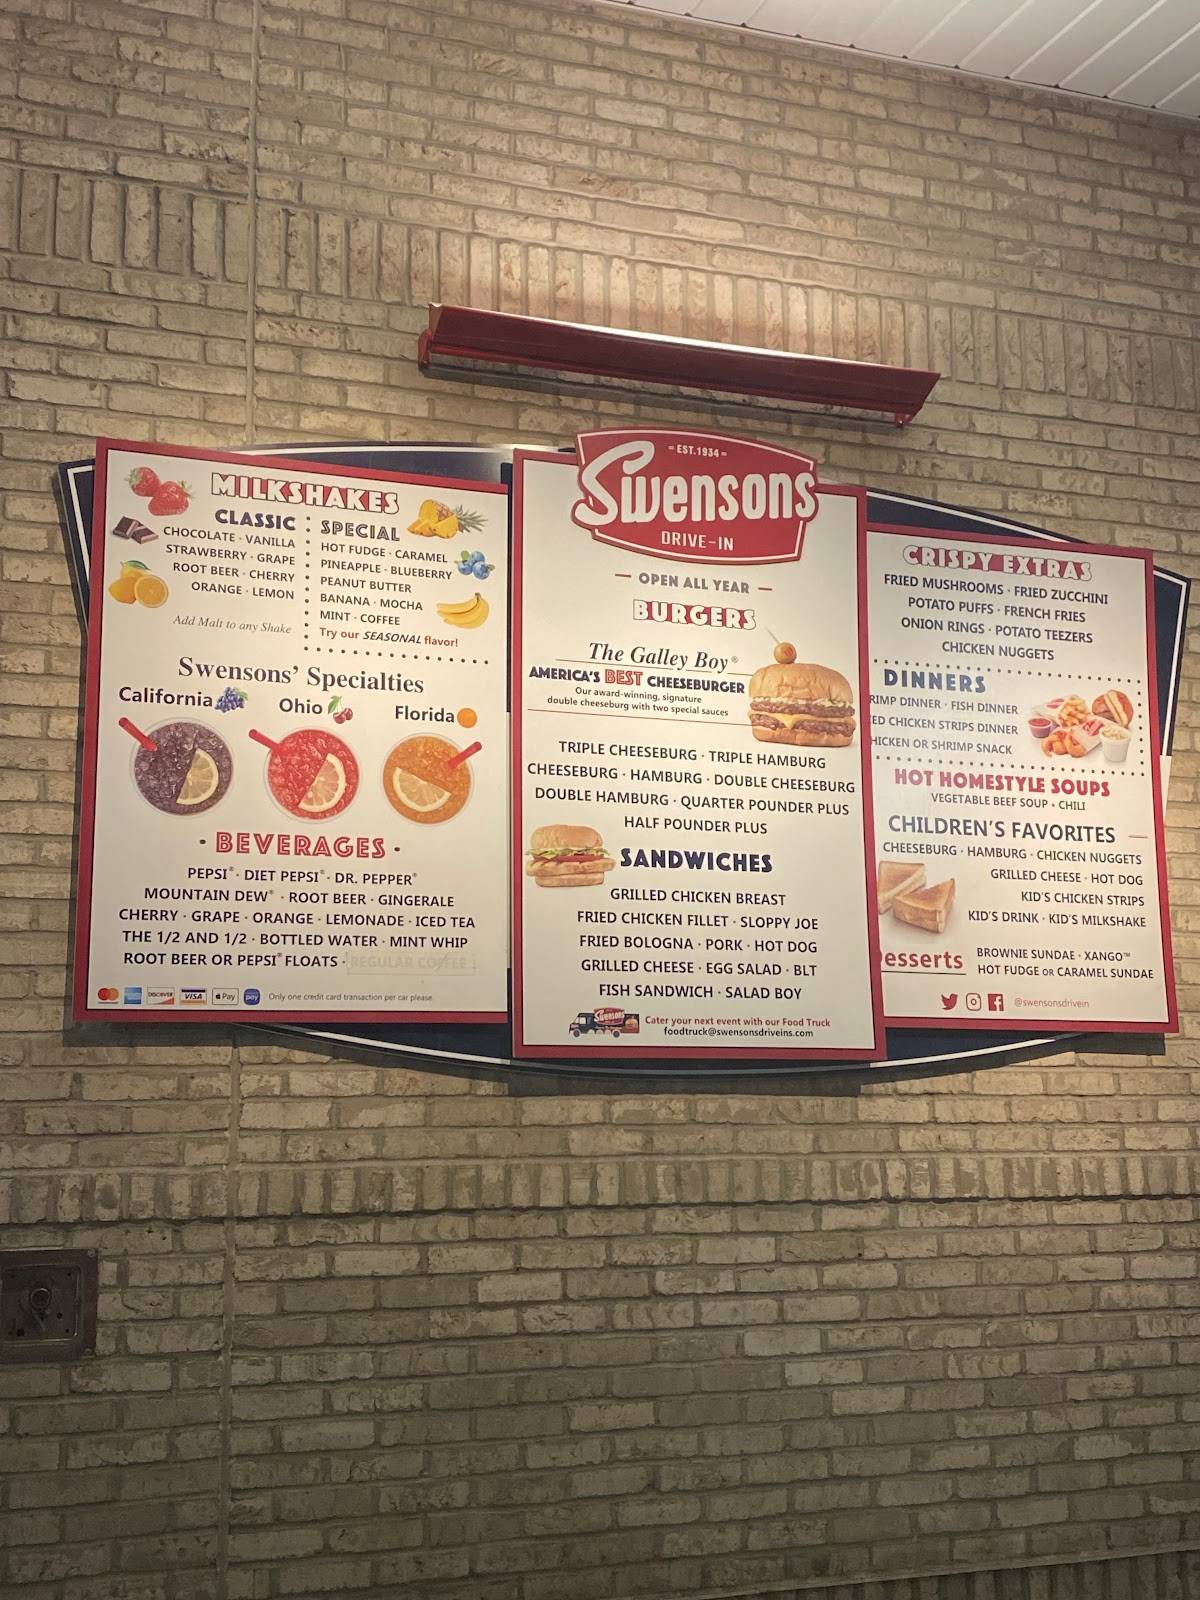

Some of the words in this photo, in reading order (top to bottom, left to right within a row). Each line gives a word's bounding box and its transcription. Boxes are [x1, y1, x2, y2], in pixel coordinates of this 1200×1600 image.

[575, 441, 816, 525] Swensons
[210, 472, 400, 515] MILKSHAKES
[215, 509, 296, 531] CLASSIC
[163, 526, 235, 542] CHOCOLATE
[246, 535, 295, 548] VANILLA
[321, 520, 400, 541] SPECIAL
[661, 530, 734, 551] DRIVE-IN
[166, 544, 247, 560] STRAWBERRY
[257, 553, 295, 565] GRAPE
[321, 542, 345, 553] HOT
[349, 545, 385, 557] FUDGE
[395, 550, 448, 563] CARAMEL
[321, 559, 381, 573] PINEAPPLE
[391, 566, 452, 580] BLUEBERRY
[902, 544, 993, 572] CRISPY
[1003, 549, 1093, 582] EXTRAS
[192, 582, 242, 595] ORANGE
[252, 587, 294, 600] LEMON
[321, 576, 366, 588] PEANUT
[370, 580, 412, 593] BUTTER
[638, 572, 679, 587] OPEN
[683, 576, 708, 590] ALL
[713, 579, 750, 594] YEAR
[884, 573, 919, 587] FRIED
[922, 577, 1004, 595] MUSHROOMS
[1014, 585, 1048, 599] FRIED
[1051, 588, 1108, 605] ZUCCHINI
[320, 611, 350, 621] MINT
[360, 614, 400, 625] COFFEE
[633, 599, 757, 630] BURGERS
[908, 596, 956, 612] POTATO
[959, 601, 994, 614] PUFFS
[1004, 605, 1051, 620] FRENCH
[1054, 609, 1086, 623] FRIES
[173, 616, 195, 626] Add
[199, 617, 222, 628] Malt
[226, 621, 236, 629] to
[239, 622, 257, 632] any
[261, 621, 291, 634] Shake
[320, 628, 336, 640] Try
[341, 630, 359, 639] our
[363, 631, 422, 644] SEASONAL
[425, 636, 458, 647] flavor!
[590, 642, 624, 661] The
[630, 645, 689, 671] Galley
[942, 641, 995, 656] CHICKEN
[999, 645, 1055, 660] NUGGETS
[178, 657, 299, 684] Swensons'
[307, 666, 424, 694] Specialties
[604, 669, 643, 687] BEST
[647, 675, 745, 694] CHEESEBURGER
[884, 668, 986, 693] DINNERS
[119, 686, 213, 708] California
[575, 687, 591, 695] Our
[594, 689, 660, 701] award-winning,
[662, 693, 702, 703] signature
[279, 698, 323, 715] Ohio
[395, 705, 455, 723] Florida
[547, 696, 578, 705] double
[580, 698, 629, 711] cheeseburg
[632, 702, 650, 711] with
[671, 705, 699, 716] special
[559, 740, 605, 755] TRIPLE
[609, 744, 697, 761] CHEESEBURG
[709, 751, 753, 765] TRIPLE
[757, 753, 826, 769] HAMBURG
[894, 768, 933, 785] HOT
[940, 770, 1046, 793] HOMESTYLE
[1051, 778, 1110, 797] SOUPS
[932, 793, 990, 806] VEGETABLE
[993, 797, 1016, 807] BEEF
[1020, 798, 1048, 809] SOUP
[1058, 800, 1086, 811] CHILI
[624, 816, 660, 829] HALF
[664, 818, 730, 833] POUNDER
[734, 821, 768, 834] PLUS
[888, 815, 1005, 838] CHILDREN'S
[1012, 821, 1116, 843] FAVORITES
[215, 832, 386, 859] BEVERAGES
[882, 842, 957, 856] CHEESEBURG
[967, 846, 1027, 859] HAMBURG
[1036, 850, 1086, 862] CHICKEN
[1090, 852, 1142, 865] NUGGETS
[620, 848, 773, 873] SANDWICHES
[990, 868, 1037, 881] GRILLED
[1040, 871, 1081, 883] CHEESE
[1091, 873, 1115, 884] HOT
[1118, 875, 1143, 886] DOG
[610, 888, 667, 902] GRILLED
[671, 890, 731, 904] CHICKEN
[736, 892, 786, 906] BREAST
[1054, 893, 1104, 905] CHICKEN
[1107, 895, 1145, 906] STRIPS
[119, 909, 178, 921] CHERRY
[191, 911, 240, 923] GRAPE
[252, 911, 314, 924] ORANGE
[326, 914, 404, 926] LEMONADE
[415, 916, 446, 927] ICED
[450, 917, 475, 928] TEA
[577, 911, 618, 924] FRIED
[621, 912, 682, 926] CHICKEN
[687, 915, 729, 927] FILLET
[740, 916, 791, 930] SLOPPY
[794, 918, 819, 930] JOE
[122, 931, 151, 943] THE
[157, 932, 180, 945] 1/2
[185, 932, 218, 944] AND
[224, 933, 247, 946] 1/2
[260, 933, 324, 946] BOTTLED
[328, 935, 377, 946] WATER
[390, 936, 426, 947] MINT
[431, 937, 468, 948] WHIP
[977, 948, 1028, 959] BROWNIE
[1031, 949, 1075, 960] SUNDAE
[978, 965, 1002, 975] HOT
[1004, 966, 1040, 976] FUDGE
[1042, 968, 1054, 976] OR
[1057, 966, 1108, 978] CARAMEL
[1110, 968, 1154, 979] SUNDAE
[269, 993, 285, 1002] Only
[410, 994, 432, 1002] please
[599, 984, 631, 997] FISH
[635, 985, 713, 998] SANDWICH
[725, 986, 770, 999] SALAD
[775, 987, 802, 1000] BOY
[1014, 996, 1090, 1008] @swensonsdrivein
[645, 1016, 668, 1024] Cater
[671, 1018, 691, 1026] your
[743, 1017, 762, 1025] with
[782, 1018, 804, 1026] Food
[806, 1019, 831, 1027] Truck
[664, 1027, 813, 1037] foodtruck@swensonsdriveins.com
